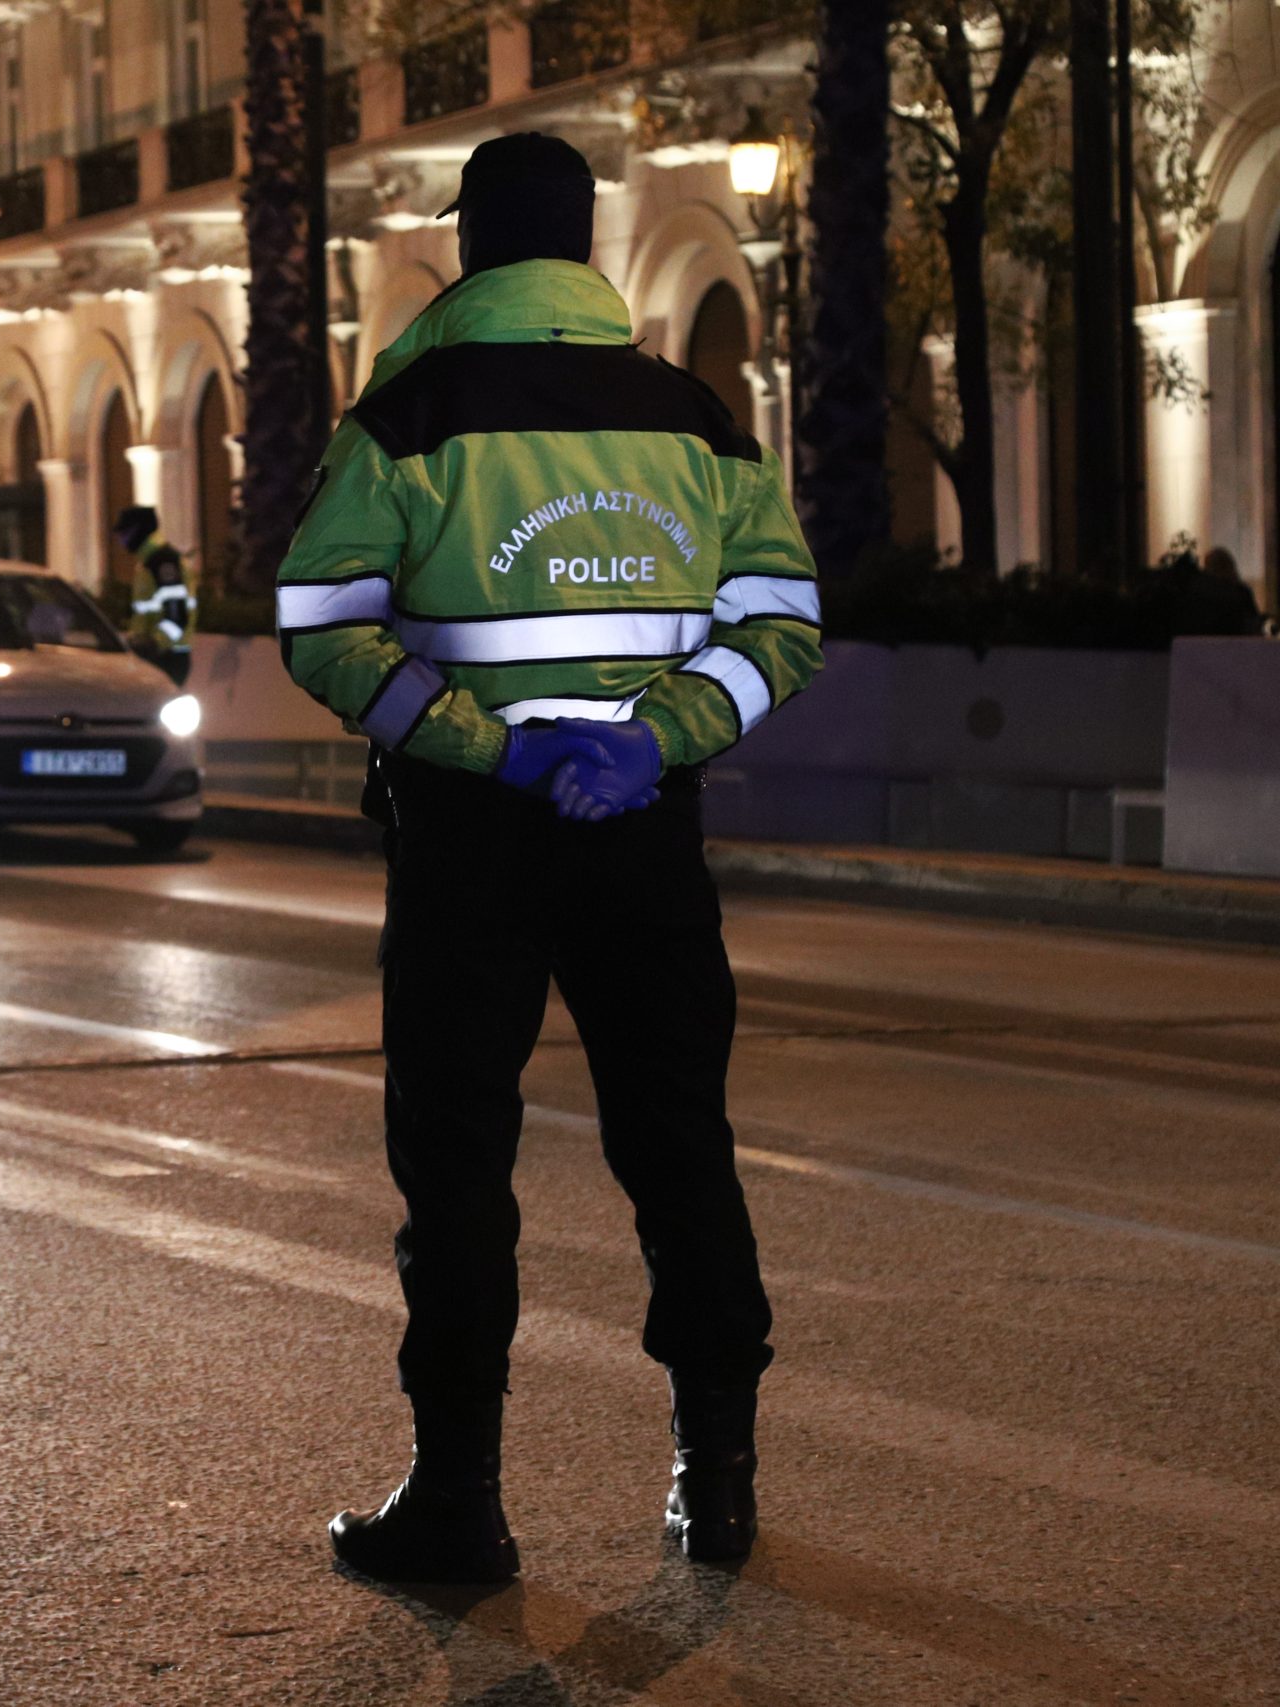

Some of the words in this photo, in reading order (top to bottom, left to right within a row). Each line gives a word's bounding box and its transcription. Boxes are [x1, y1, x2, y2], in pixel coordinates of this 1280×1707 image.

[489, 491, 588, 575] ΕΛΛΗΝΙΚΗ
[593, 490, 699, 564] ΑΣΤΥΝΟΜΙΑ
[548, 556, 656, 584] POLICE
